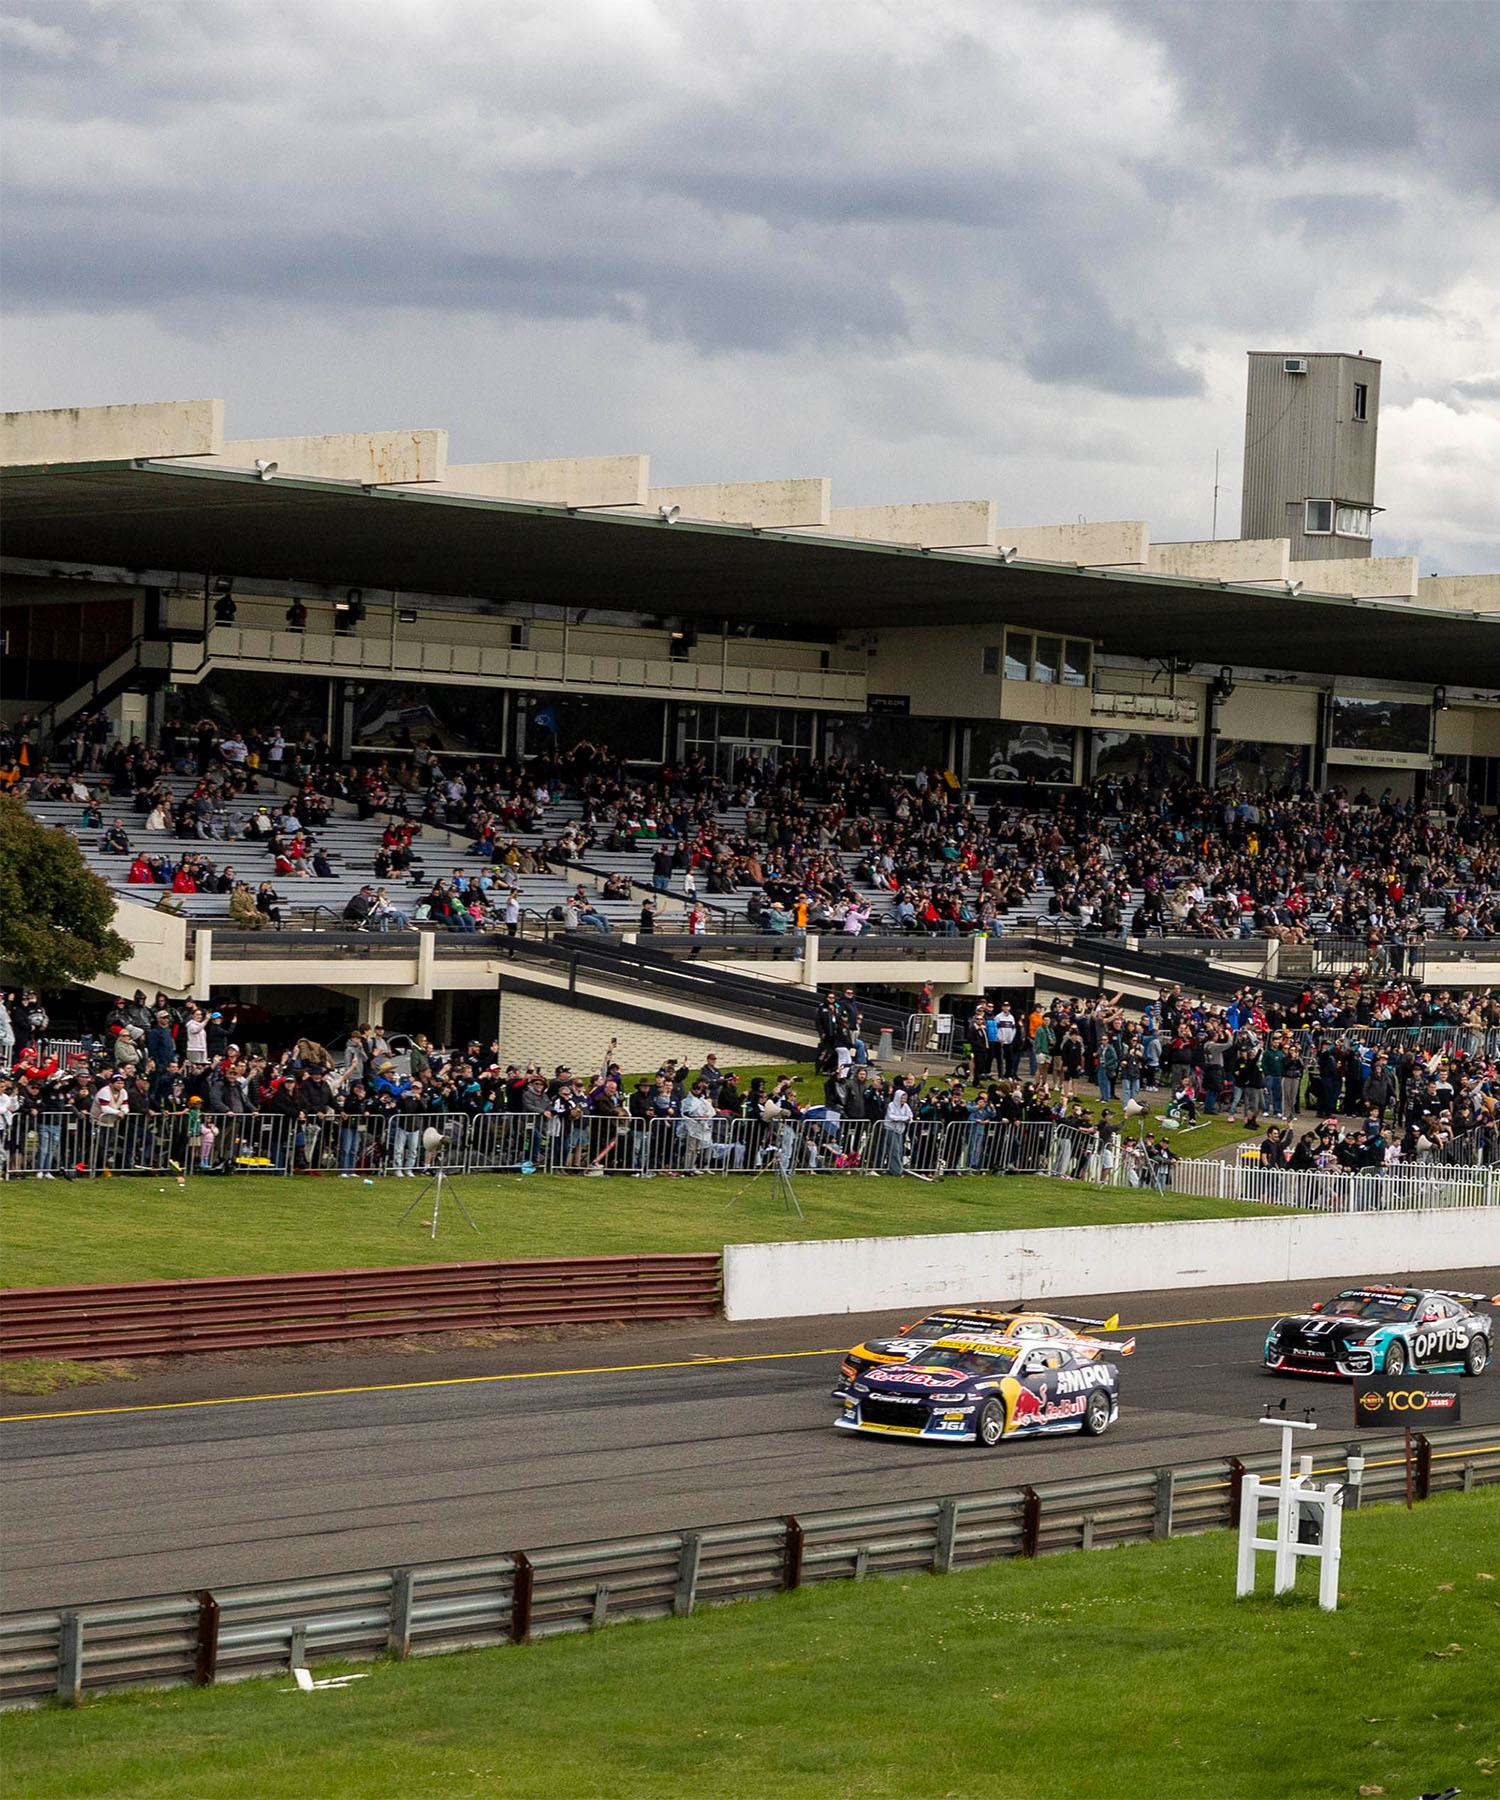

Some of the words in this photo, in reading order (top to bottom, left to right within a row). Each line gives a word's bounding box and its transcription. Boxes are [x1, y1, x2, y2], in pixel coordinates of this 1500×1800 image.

[1415, 1326, 1470, 1358] OPTUS
[864, 1370, 910, 1382] Red
[909, 1374, 962, 1388] Bull
[1056, 1364, 1115, 1395] AMPOL
[1045, 1401, 1062, 1418] Red
[1060, 1395, 1087, 1416] Bull
[1386, 1391, 1428, 1410] 100
[935, 1421, 966, 1430] JGI
